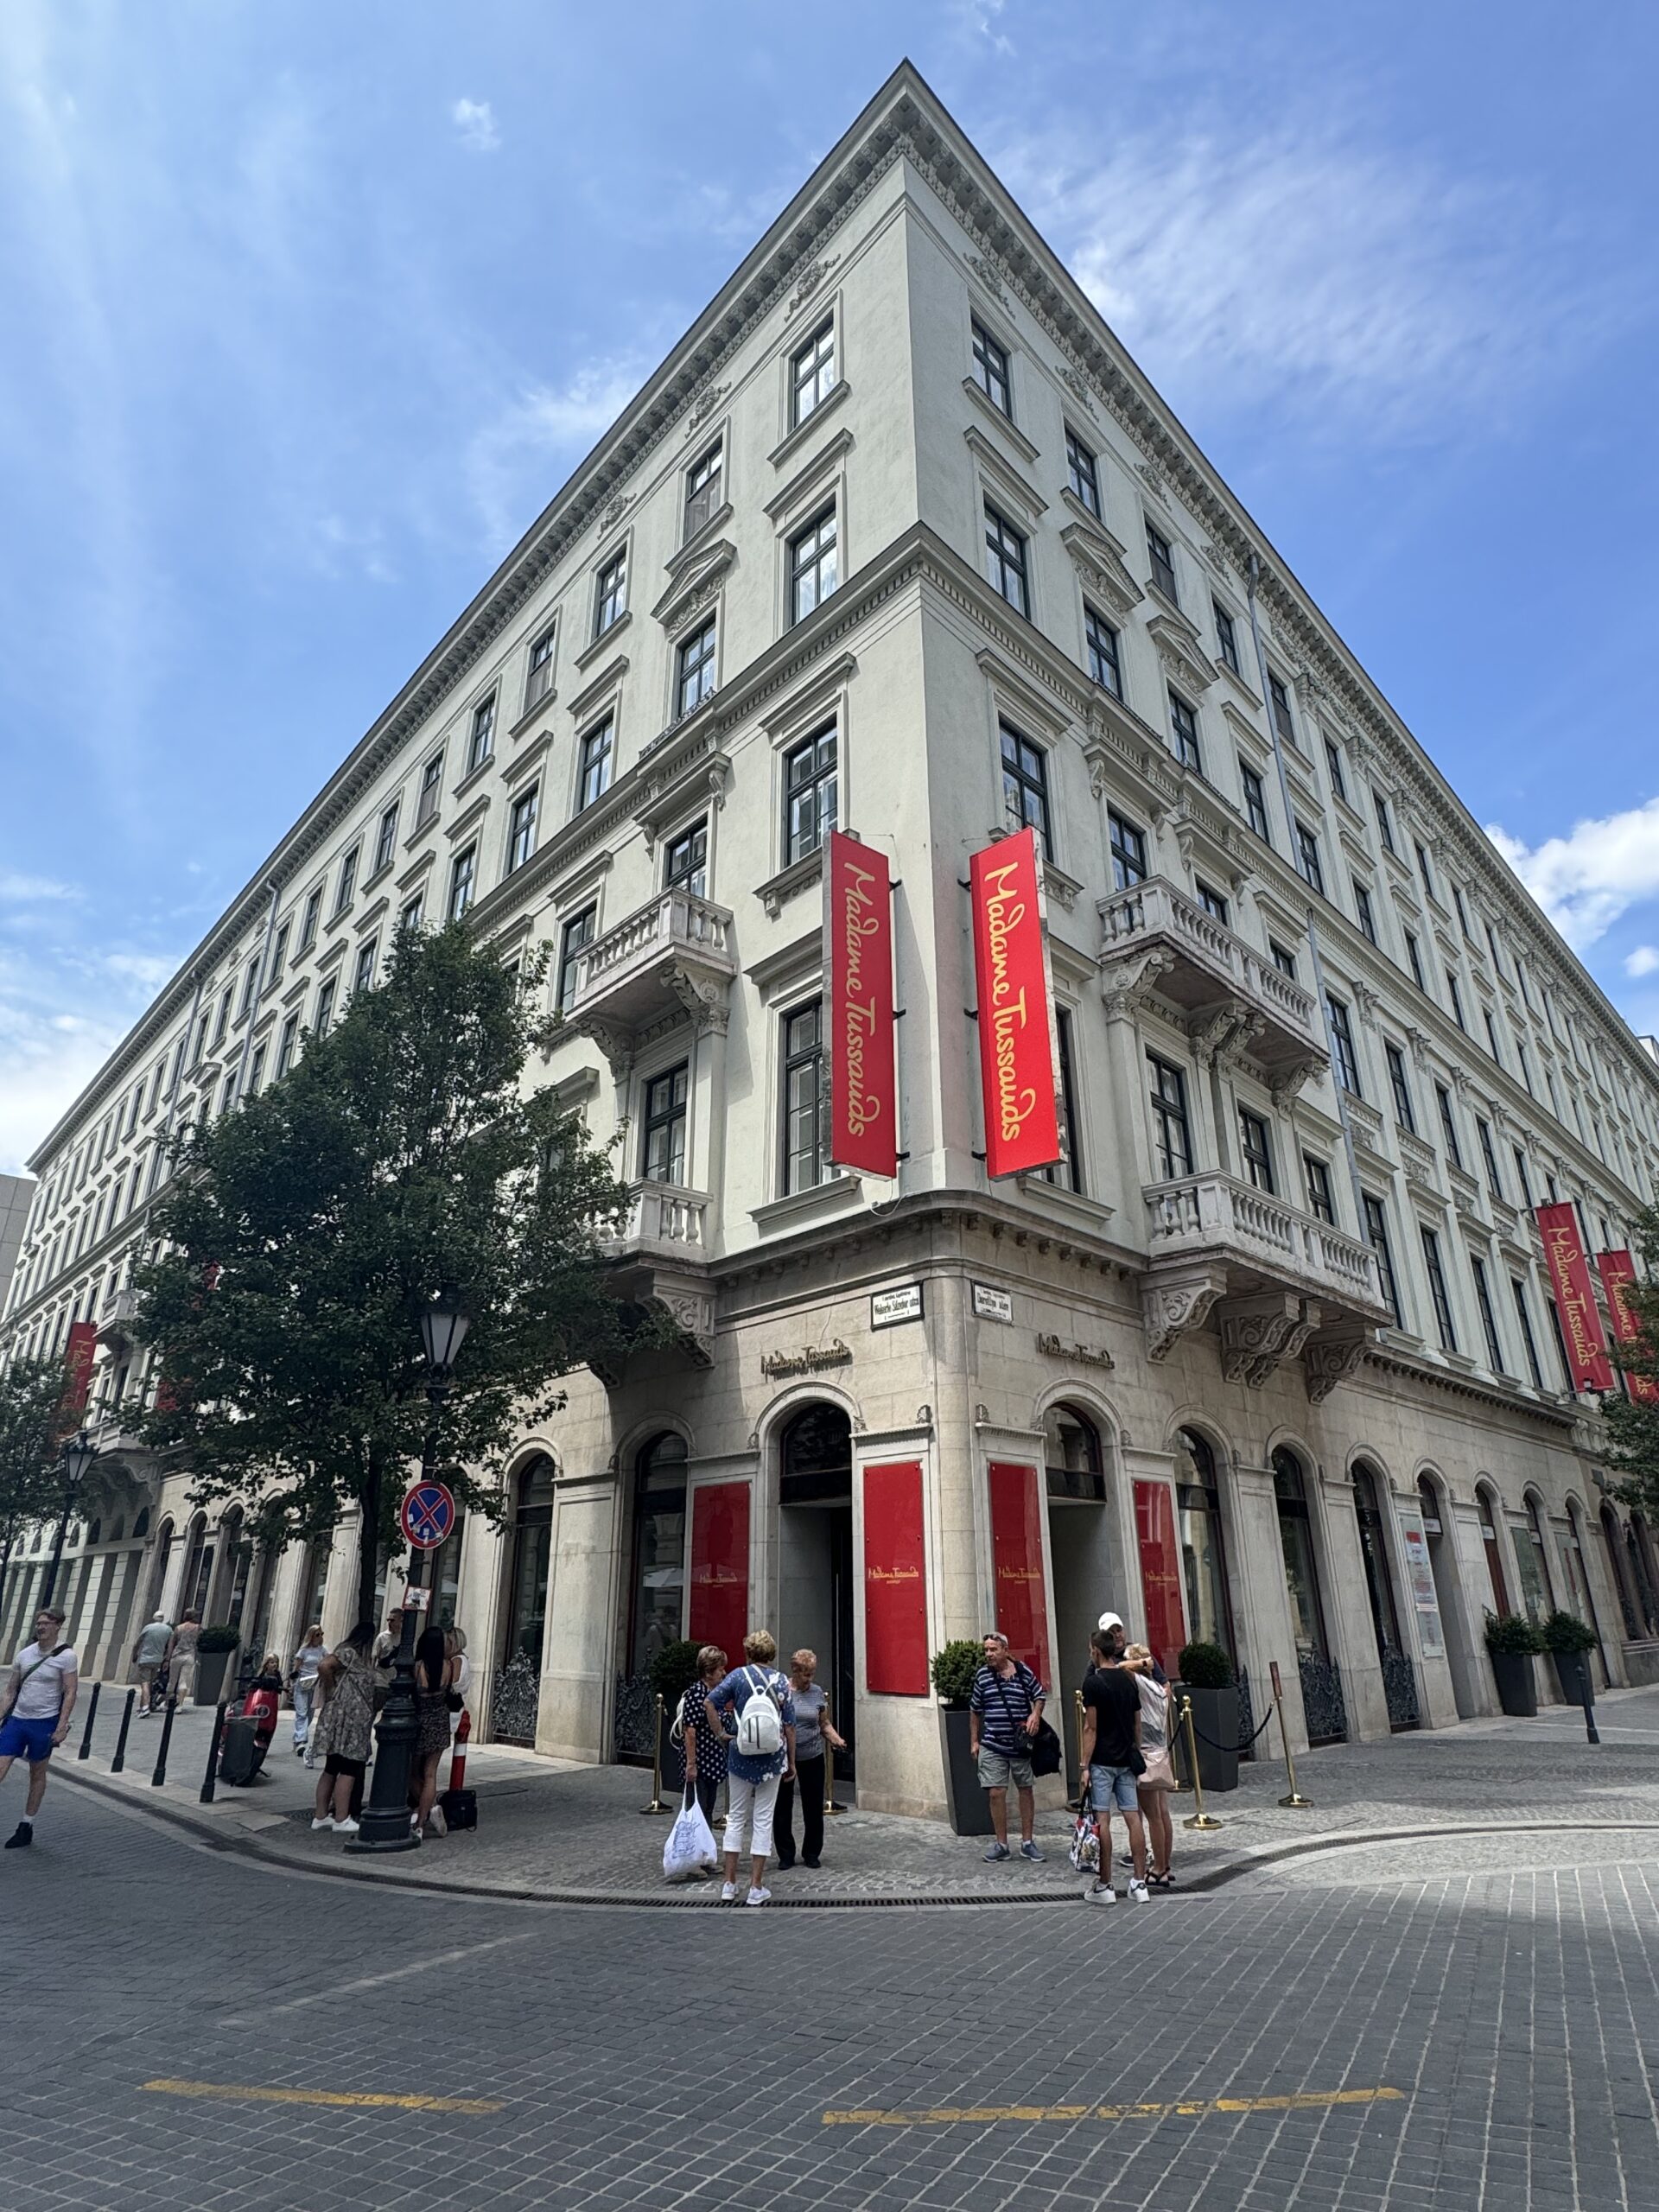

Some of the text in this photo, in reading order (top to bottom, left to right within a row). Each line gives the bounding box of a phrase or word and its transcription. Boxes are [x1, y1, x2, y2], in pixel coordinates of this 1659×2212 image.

[844, 861, 880, 1137] Madame Tussauds
[985, 861, 1036, 1141] Madame Tussauds
[1548, 1227, 1598, 1367] Madame Tussauds
